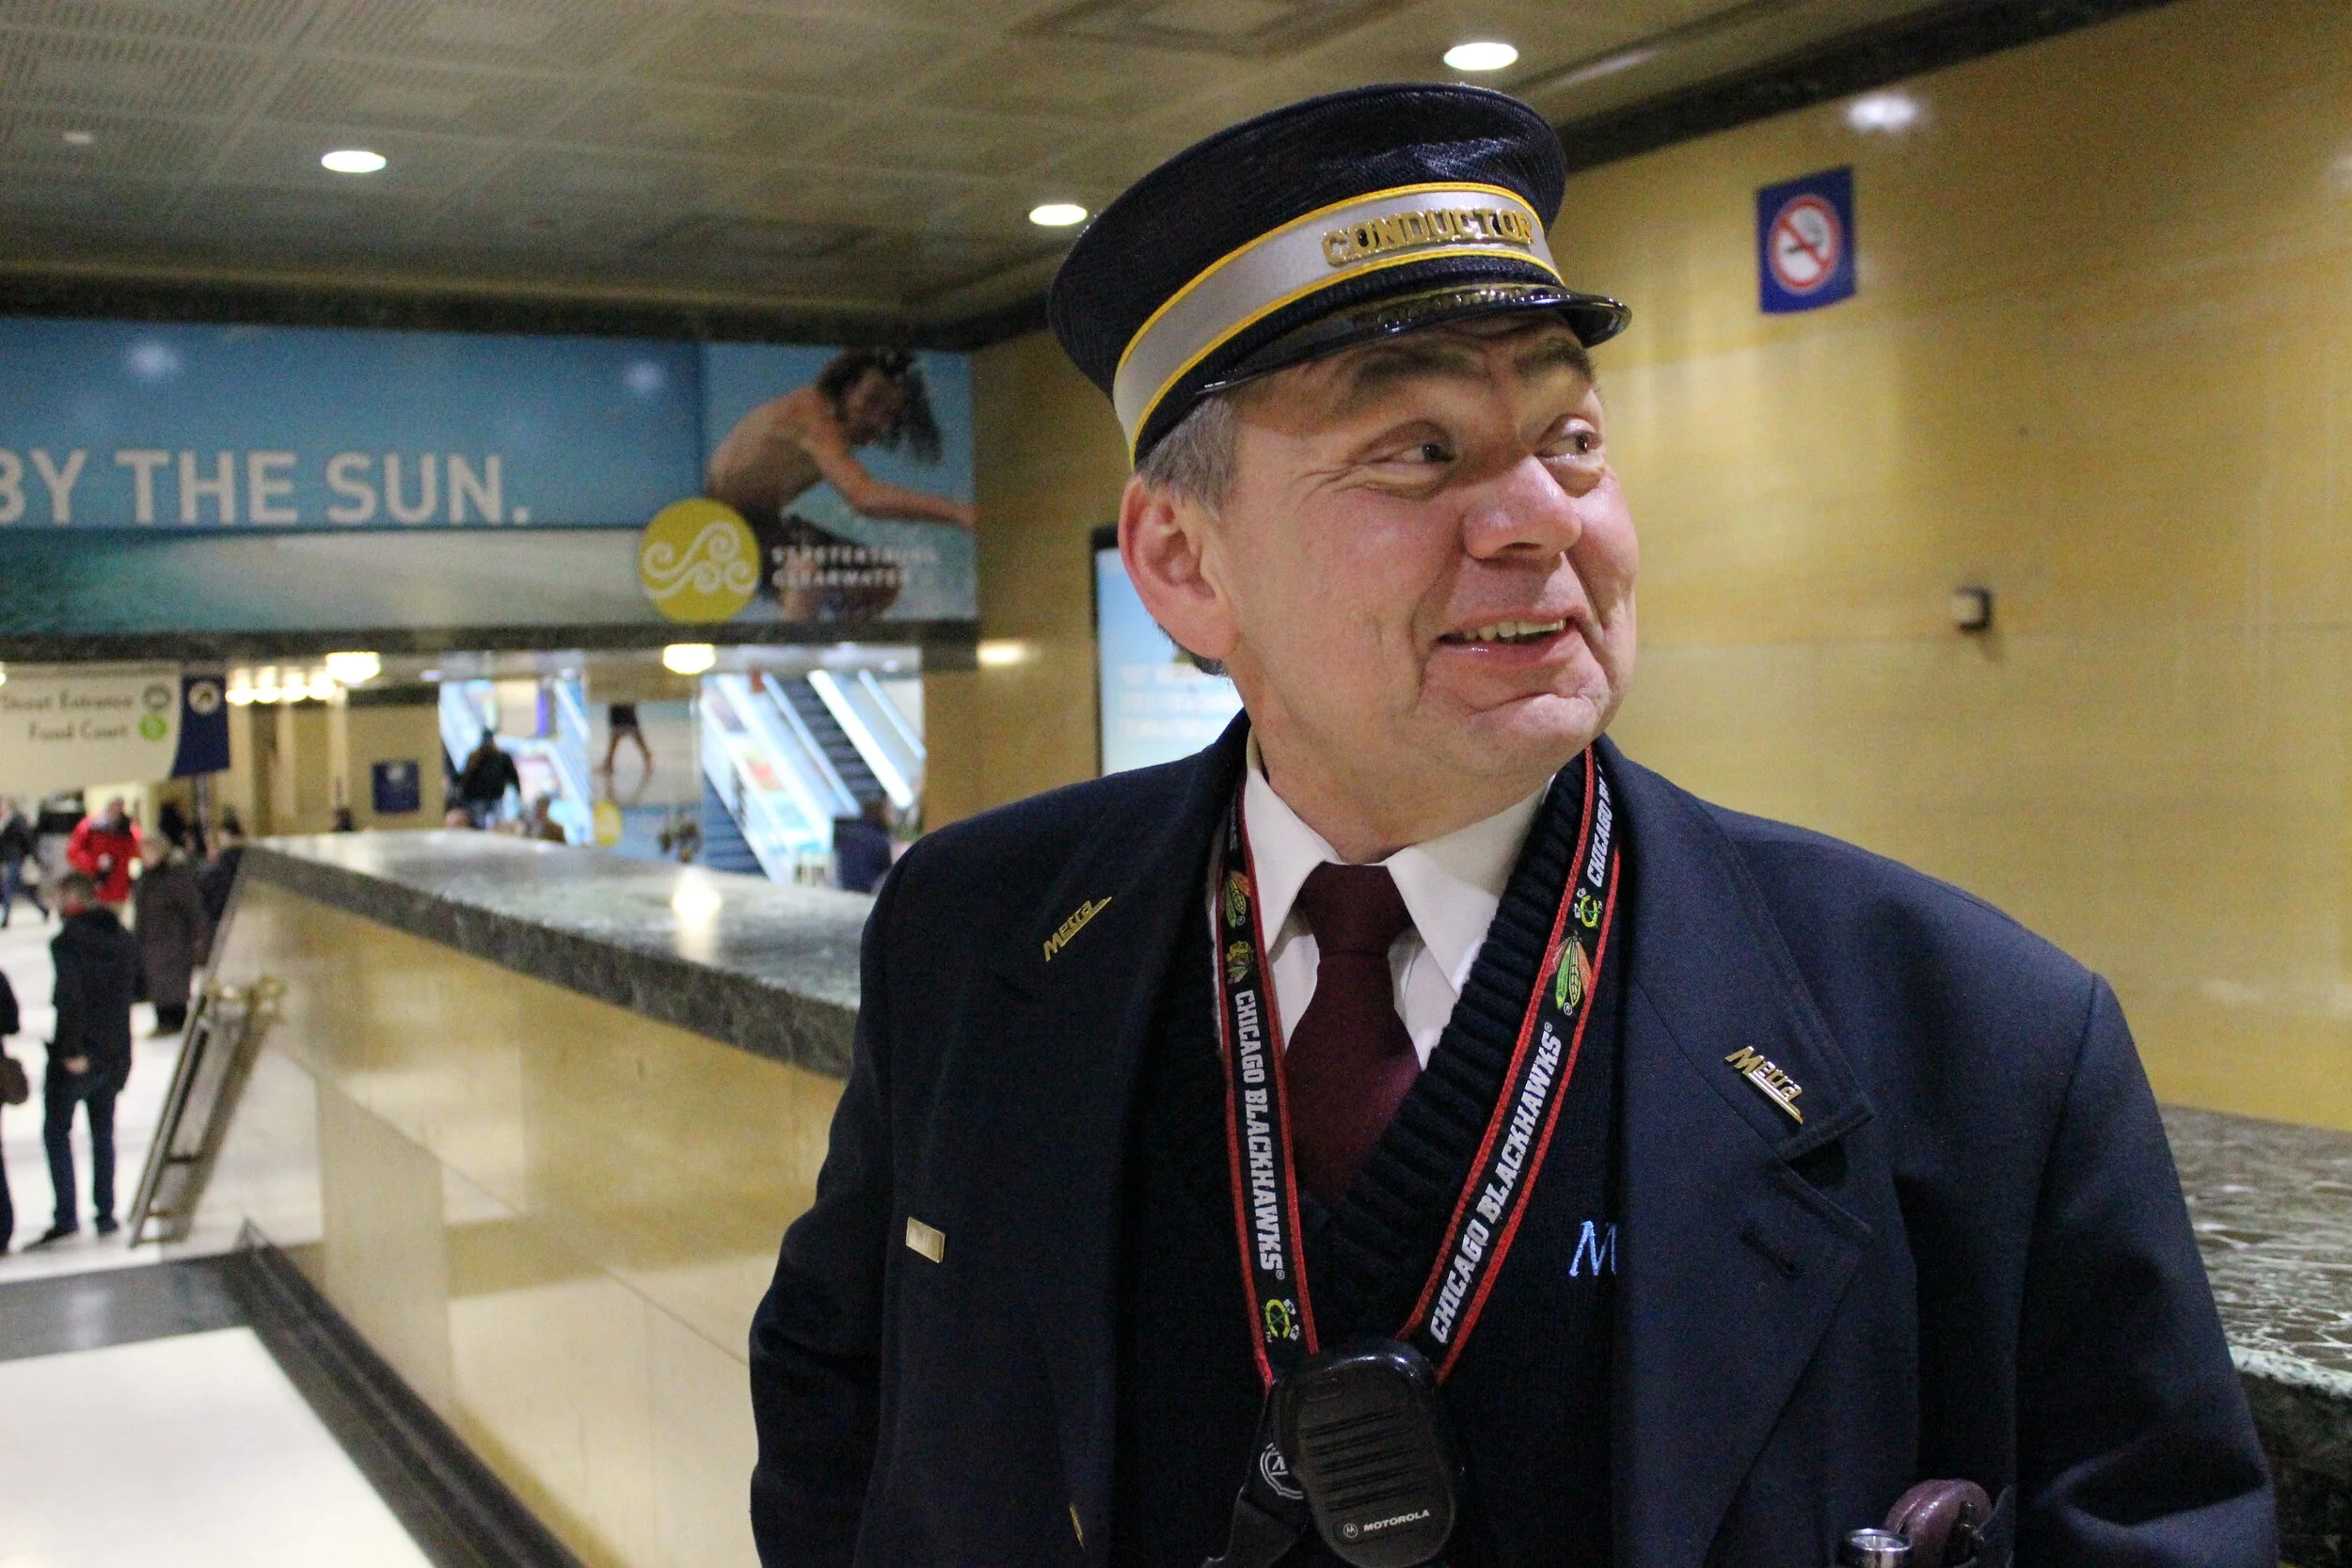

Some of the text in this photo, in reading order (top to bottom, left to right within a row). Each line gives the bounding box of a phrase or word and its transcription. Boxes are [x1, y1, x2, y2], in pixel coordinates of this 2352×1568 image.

[1321, 207, 1535, 267] CONDUCTOR
[114, 450, 299, 525] THE
[325, 451, 531, 525] SUN.
[1587, 800, 1613, 888] CHICAGO
[1234, 990, 1265, 1084] CHICAGO
[1724, 1045, 1804, 1110] Metra
[1430, 1219, 1489, 1343] CHICAGO
[1363, 1509, 1430, 1532] MOTOROLA
